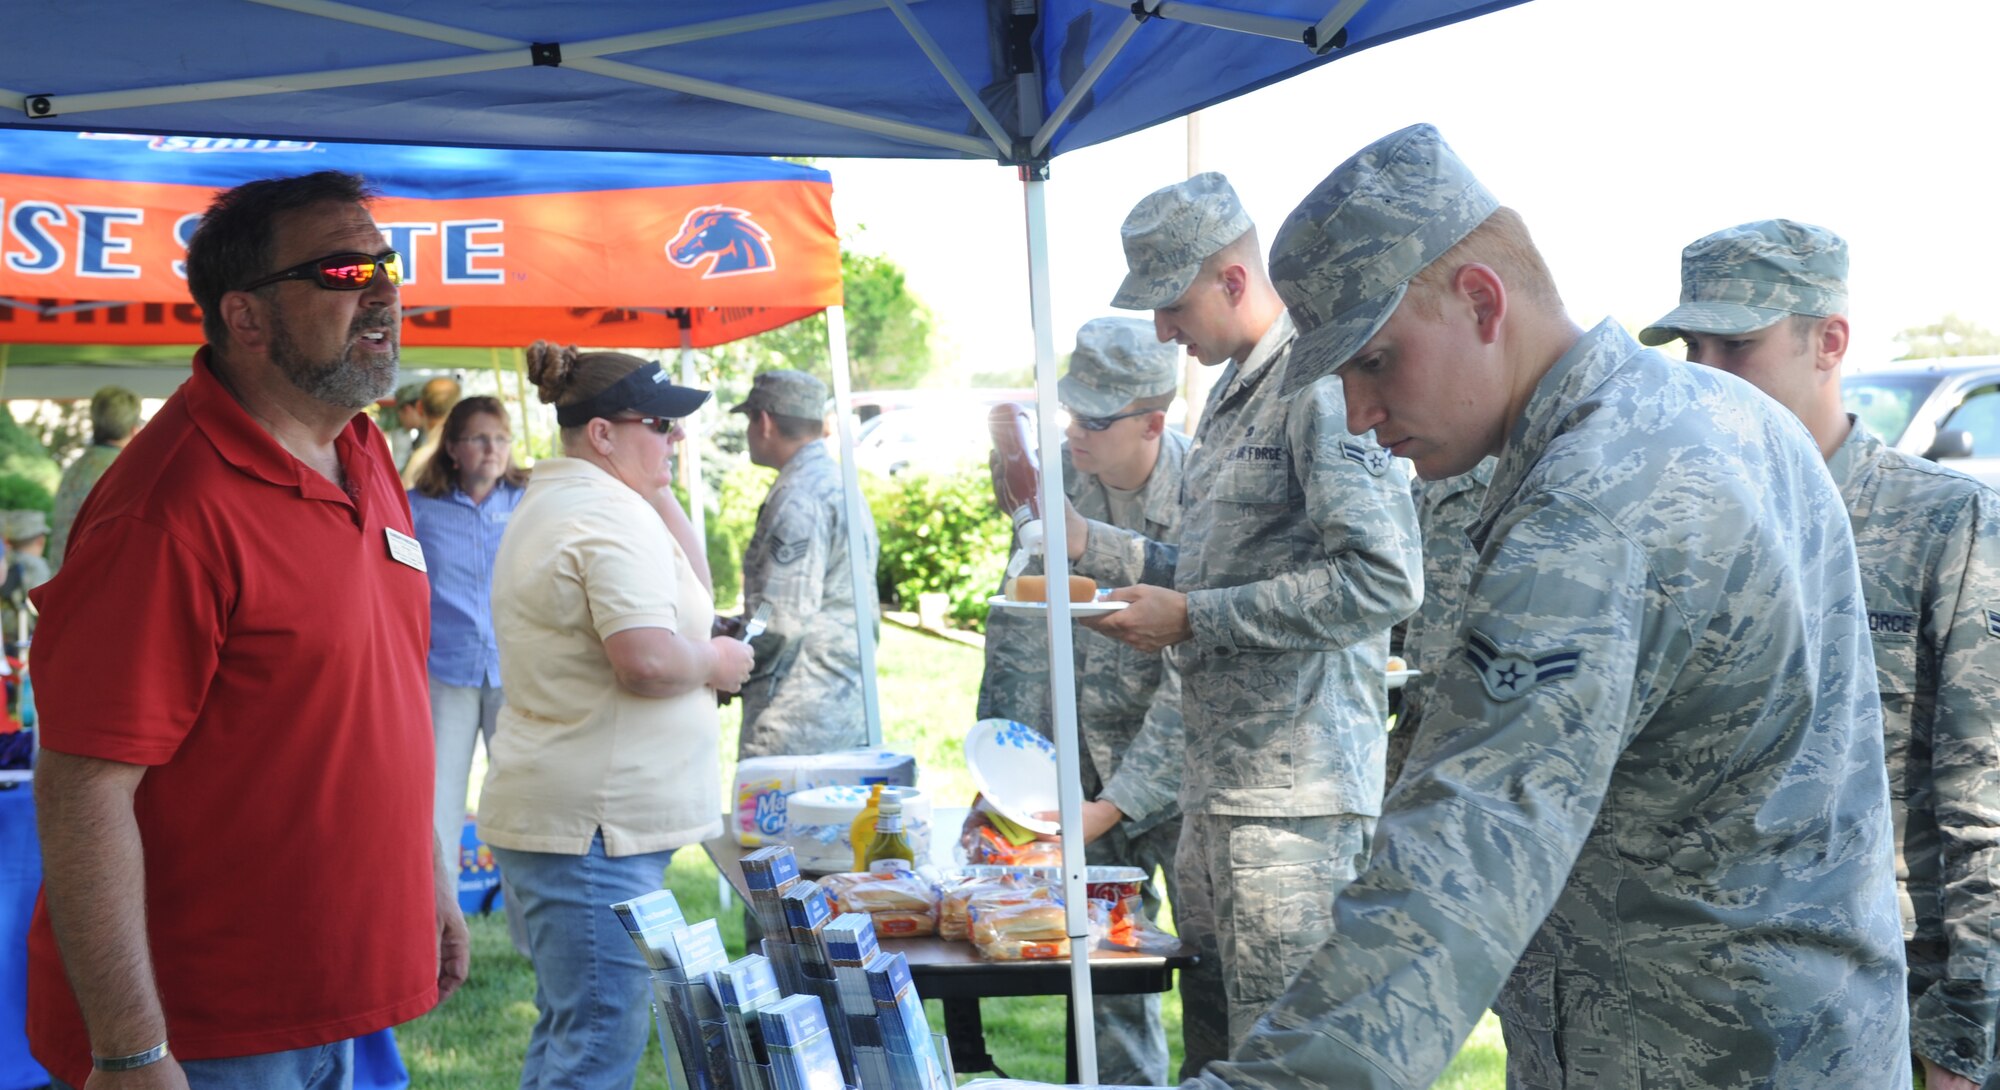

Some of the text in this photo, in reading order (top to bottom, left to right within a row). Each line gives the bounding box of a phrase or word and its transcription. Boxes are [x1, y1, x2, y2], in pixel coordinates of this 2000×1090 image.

[0, 198, 143, 280] SE
[1249, 447, 1282, 460] FORCE
[1868, 612, 1913, 633] ORCE
[756, 791, 786, 820] Ma
